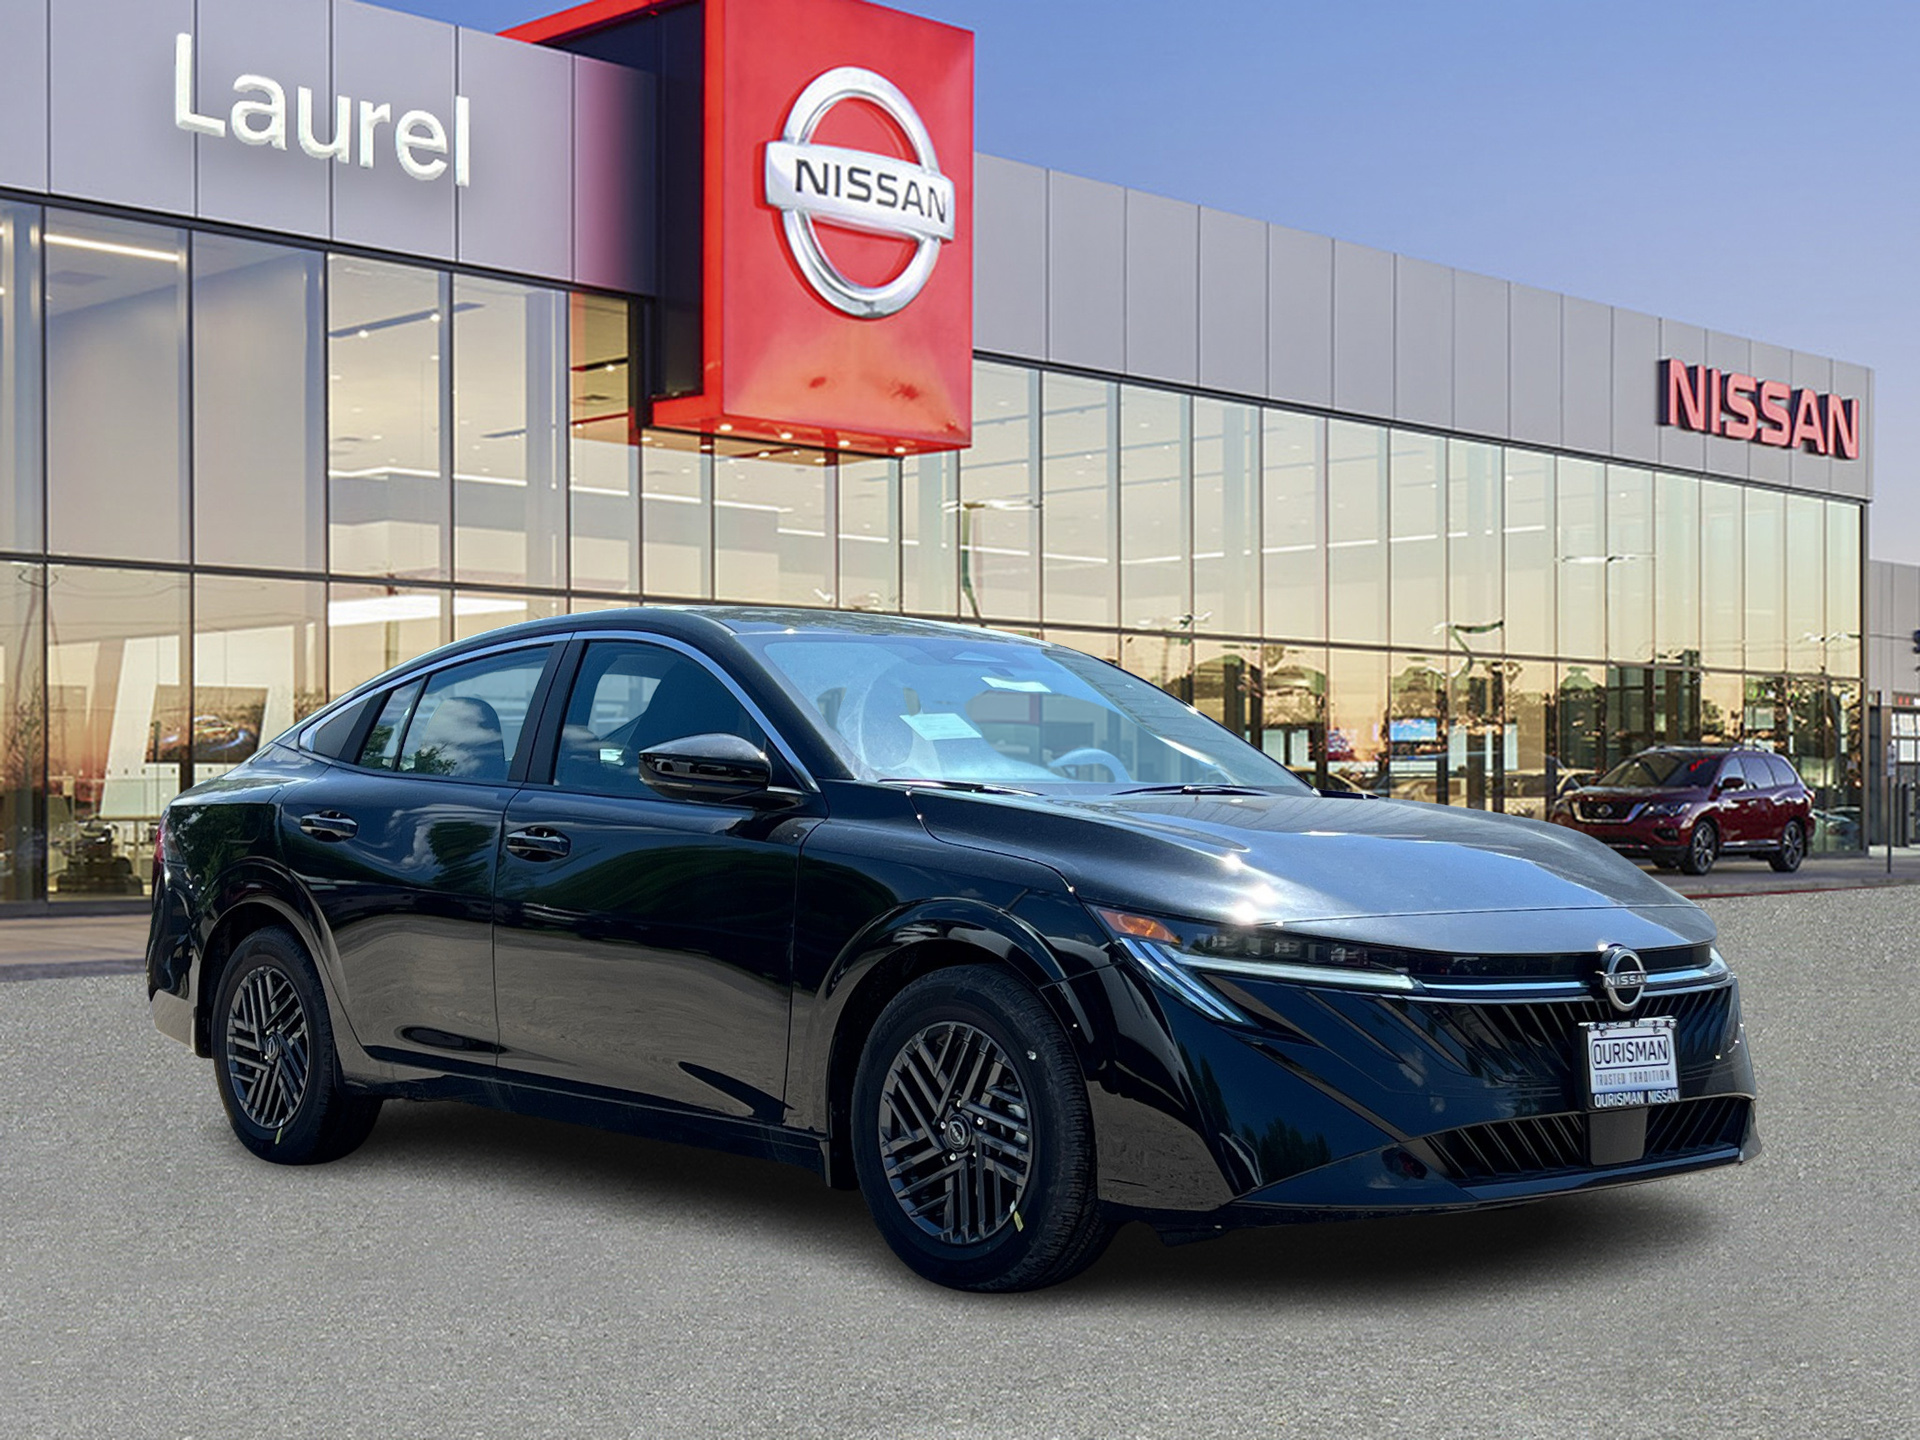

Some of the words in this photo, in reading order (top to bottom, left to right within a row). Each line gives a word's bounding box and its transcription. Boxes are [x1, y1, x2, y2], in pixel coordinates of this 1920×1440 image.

[175, 32, 470, 188] Laurel
[795, 158, 947, 224] NISSAN
[1659, 358, 1860, 460] NISSAN
[1593, 1040, 1668, 1065] OURISMAN
[1594, 1091, 1645, 1108] OURISMAN
[1647, 1088, 1680, 1104] NISSAN
[1595, 1072, 1626, 1086] TRUSTED
[1629, 1069, 1670, 1084] TRADITION
